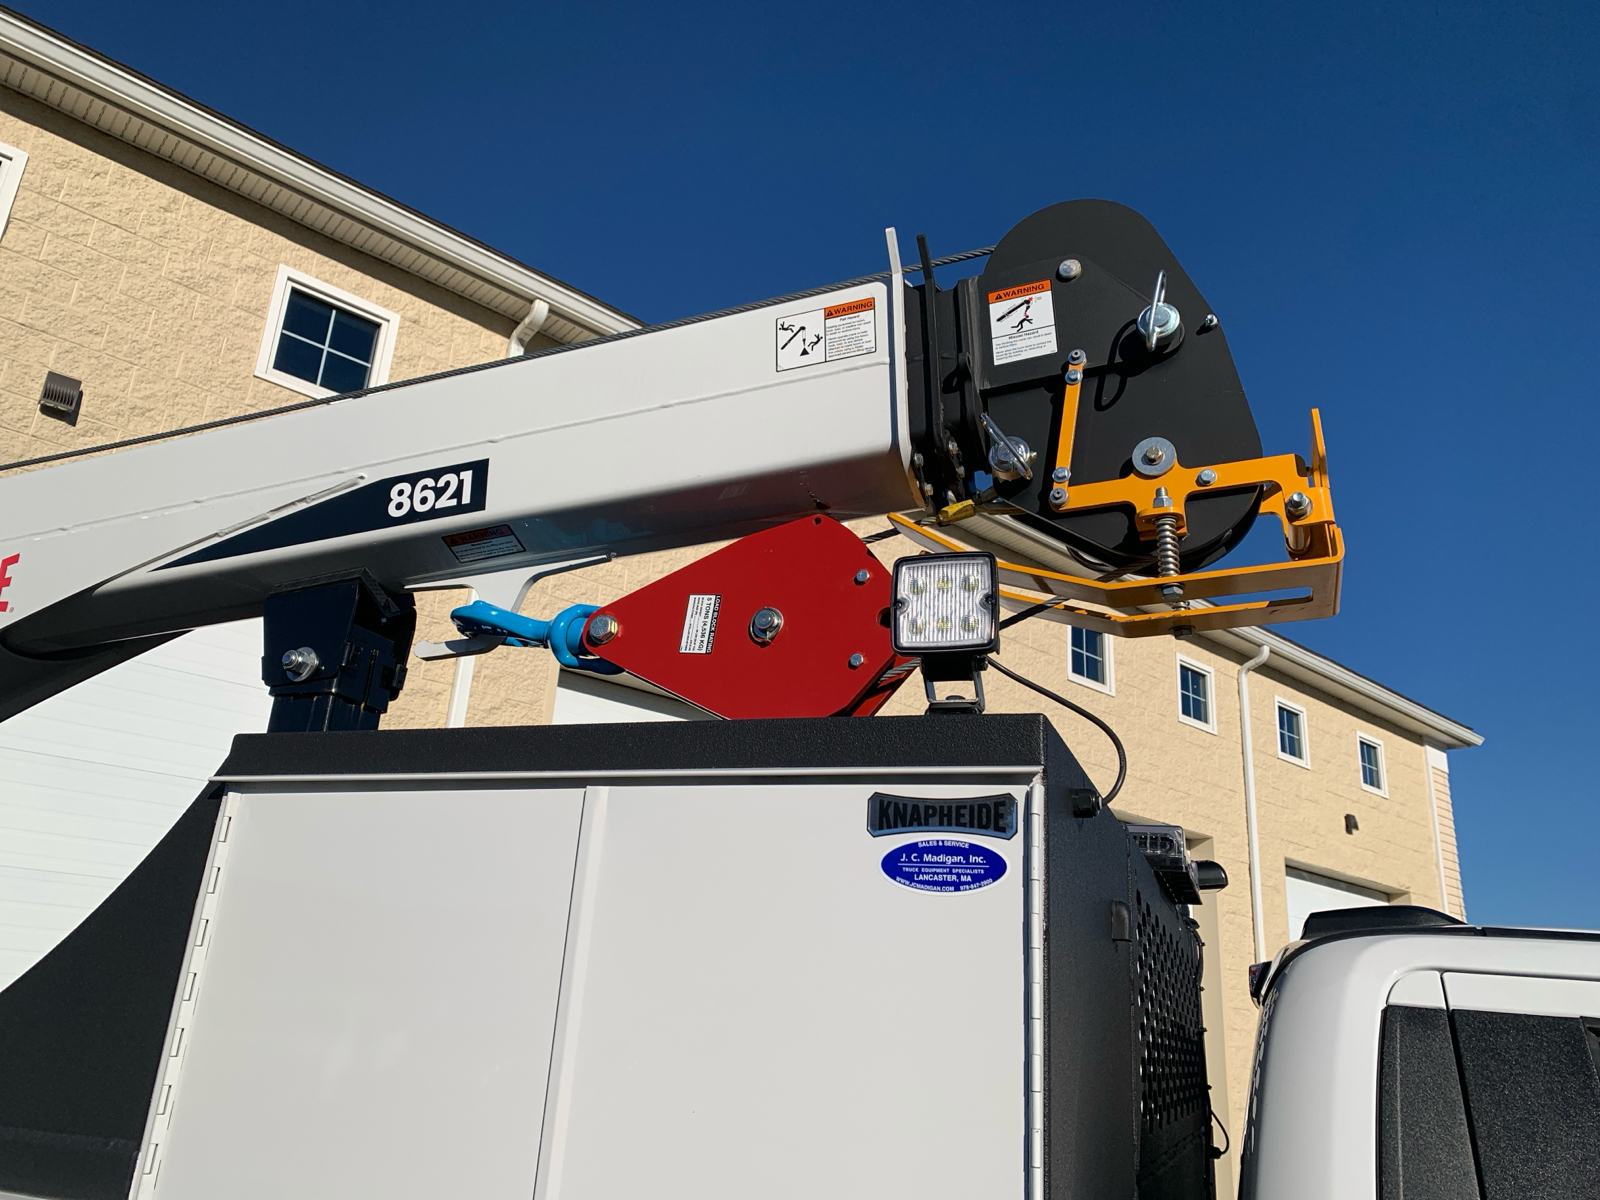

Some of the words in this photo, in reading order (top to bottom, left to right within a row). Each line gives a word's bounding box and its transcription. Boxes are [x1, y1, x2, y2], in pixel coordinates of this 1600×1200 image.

[1003, 284, 1044, 298] WARNING
[834, 301, 872, 314] WARNING
[388, 470, 473, 518] 8621
[458, 528, 504, 542] WARNING
[703, 603, 712, 620] TONS
[710, 612, 718, 631] BLOCK
[706, 632, 714, 653] RATING
[878, 799, 1007, 833] KNAPHEIDE
[944, 840, 970, 849] SERVICE
[900, 853, 908, 862] J.
[911, 853, 920, 862] C.
[923, 854, 966, 864] Madigan,
[969, 855, 986, 864] Inc.
[896, 876, 954, 892] WWW.JCMADIGAN.COM
[914, 874, 959, 882] LANCASTER,
